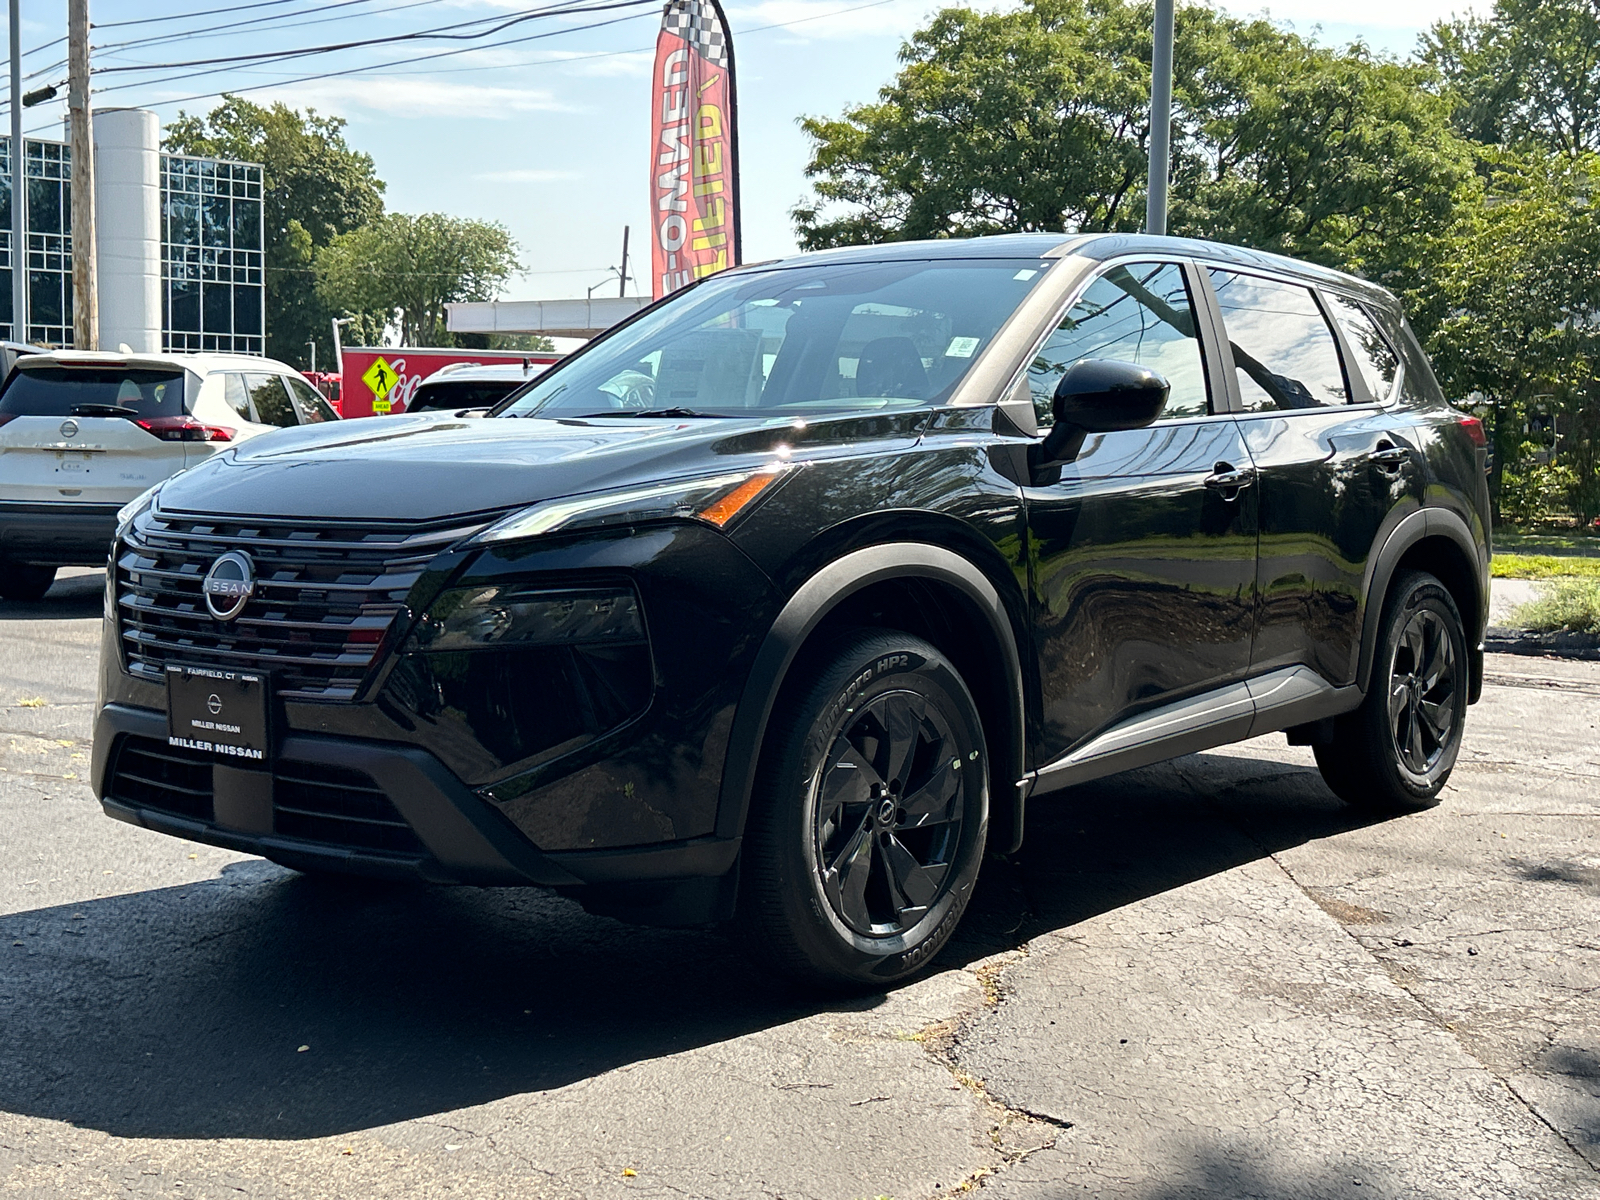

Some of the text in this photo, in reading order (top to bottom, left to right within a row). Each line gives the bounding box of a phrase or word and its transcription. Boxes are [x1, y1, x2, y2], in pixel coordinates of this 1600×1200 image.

[877, 654, 909, 674] HP2
[187, 668, 225, 680] FAIRFIELD,
[192, 720, 241, 733] MILLER NISSAN
[169, 737, 263, 759] MILLER NISSAN
